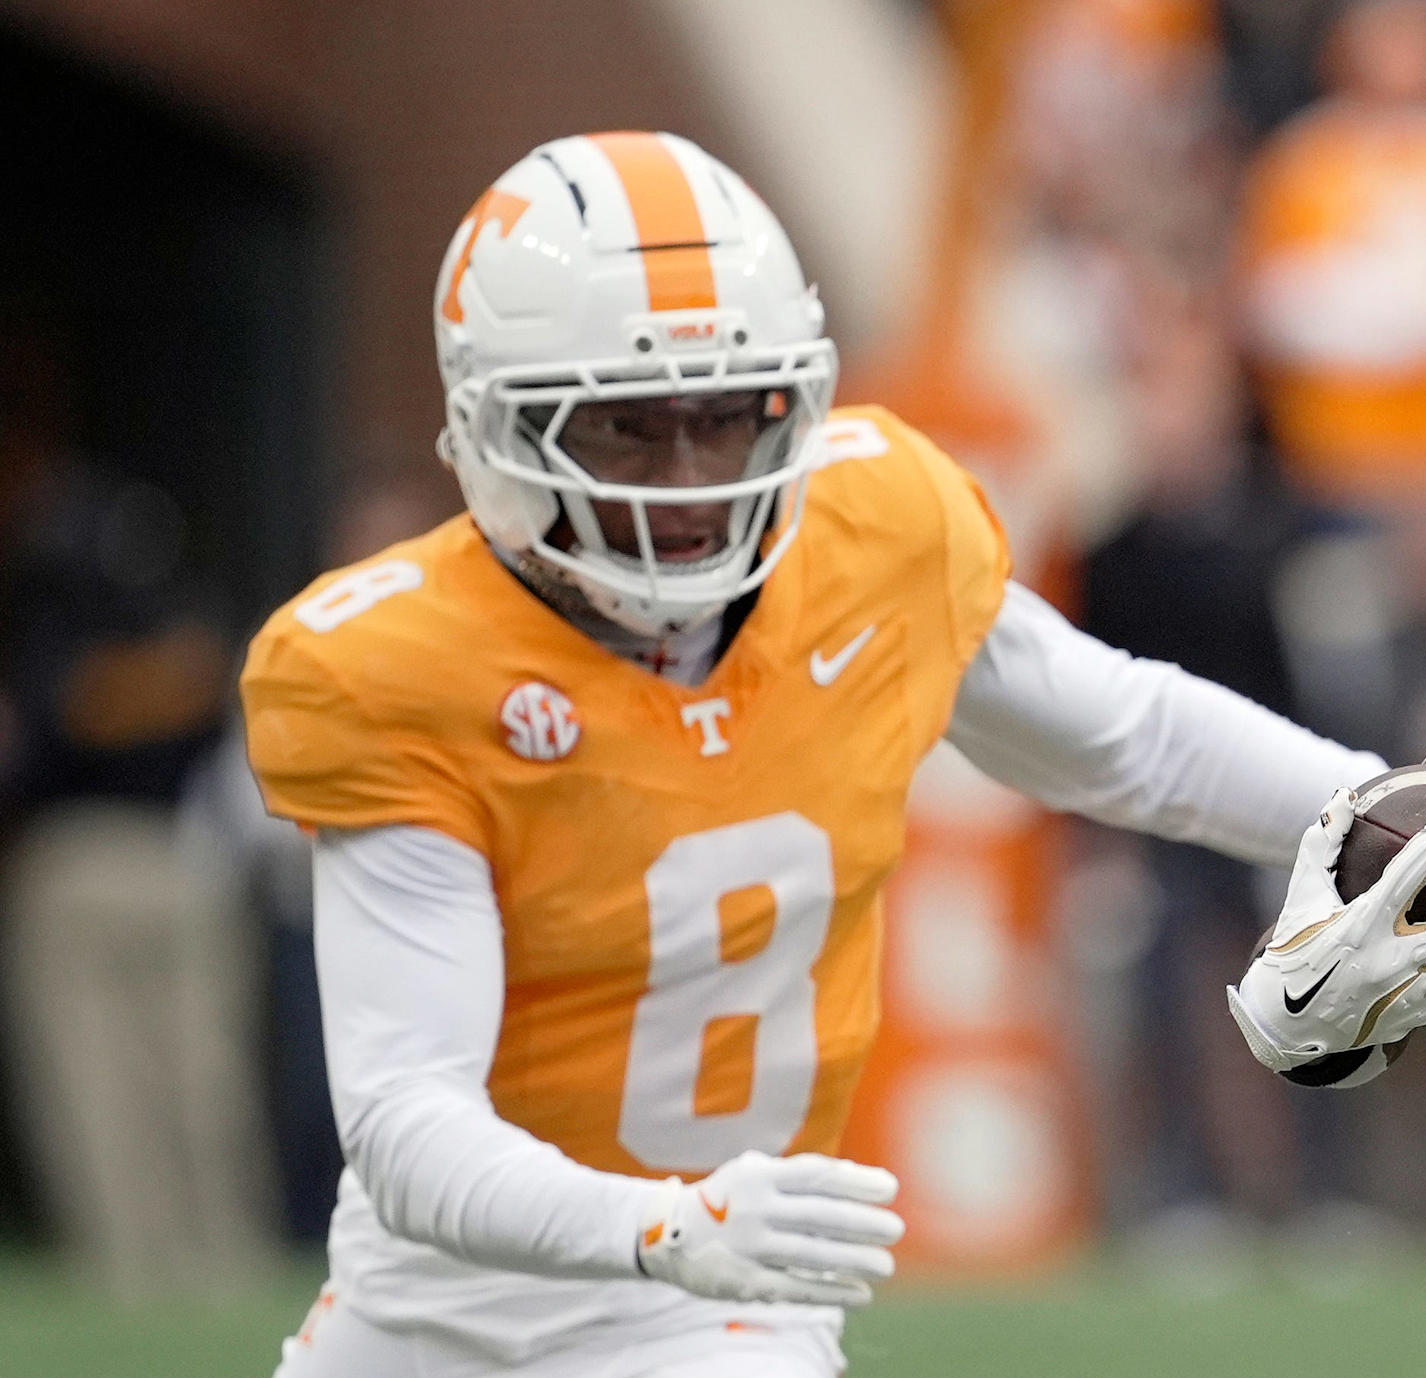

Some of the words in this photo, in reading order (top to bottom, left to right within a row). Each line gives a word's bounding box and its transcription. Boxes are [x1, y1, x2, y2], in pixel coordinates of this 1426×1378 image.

[442, 187, 532, 323] T
[294, 560, 424, 633] 8
[501, 682, 580, 761] SEC
[681, 697, 731, 757] T
[618, 810, 834, 1173] 8
